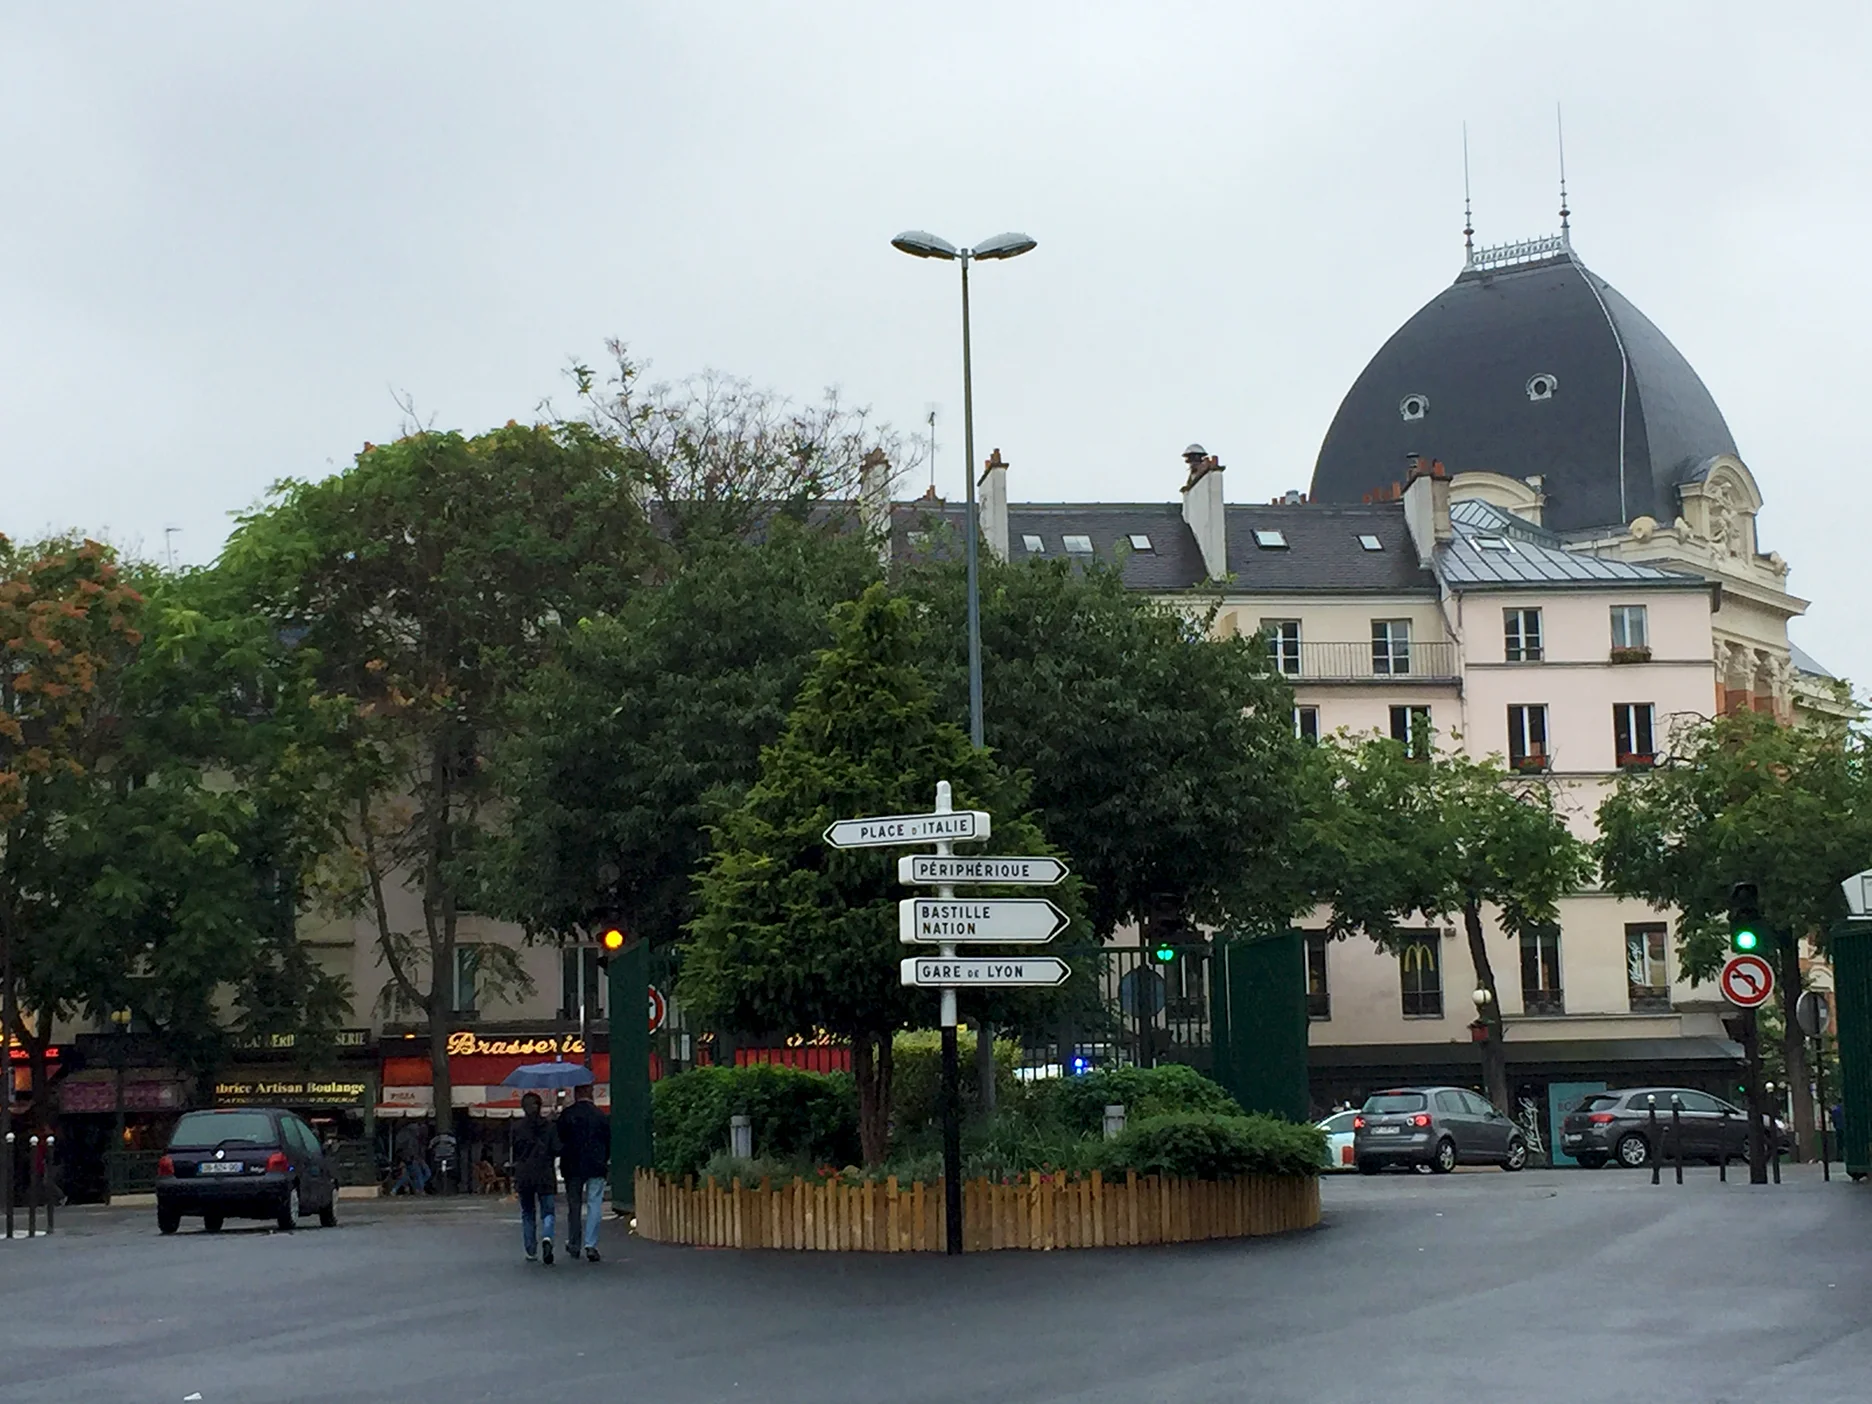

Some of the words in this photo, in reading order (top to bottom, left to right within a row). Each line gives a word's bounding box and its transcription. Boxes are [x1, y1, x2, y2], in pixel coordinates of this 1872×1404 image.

[861, 824, 904, 839] PLACE
[920, 862, 1030, 877] PÉRIPHÉRIQUE
[922, 906, 991, 919] BASTILLE
[923, 923, 976, 935] NATION
[922, 965, 961, 978] GARE
[987, 965, 1023, 978] LYON
[447, 1032, 586, 1055] Brasserie
[255, 1082, 303, 1094] Artisan
